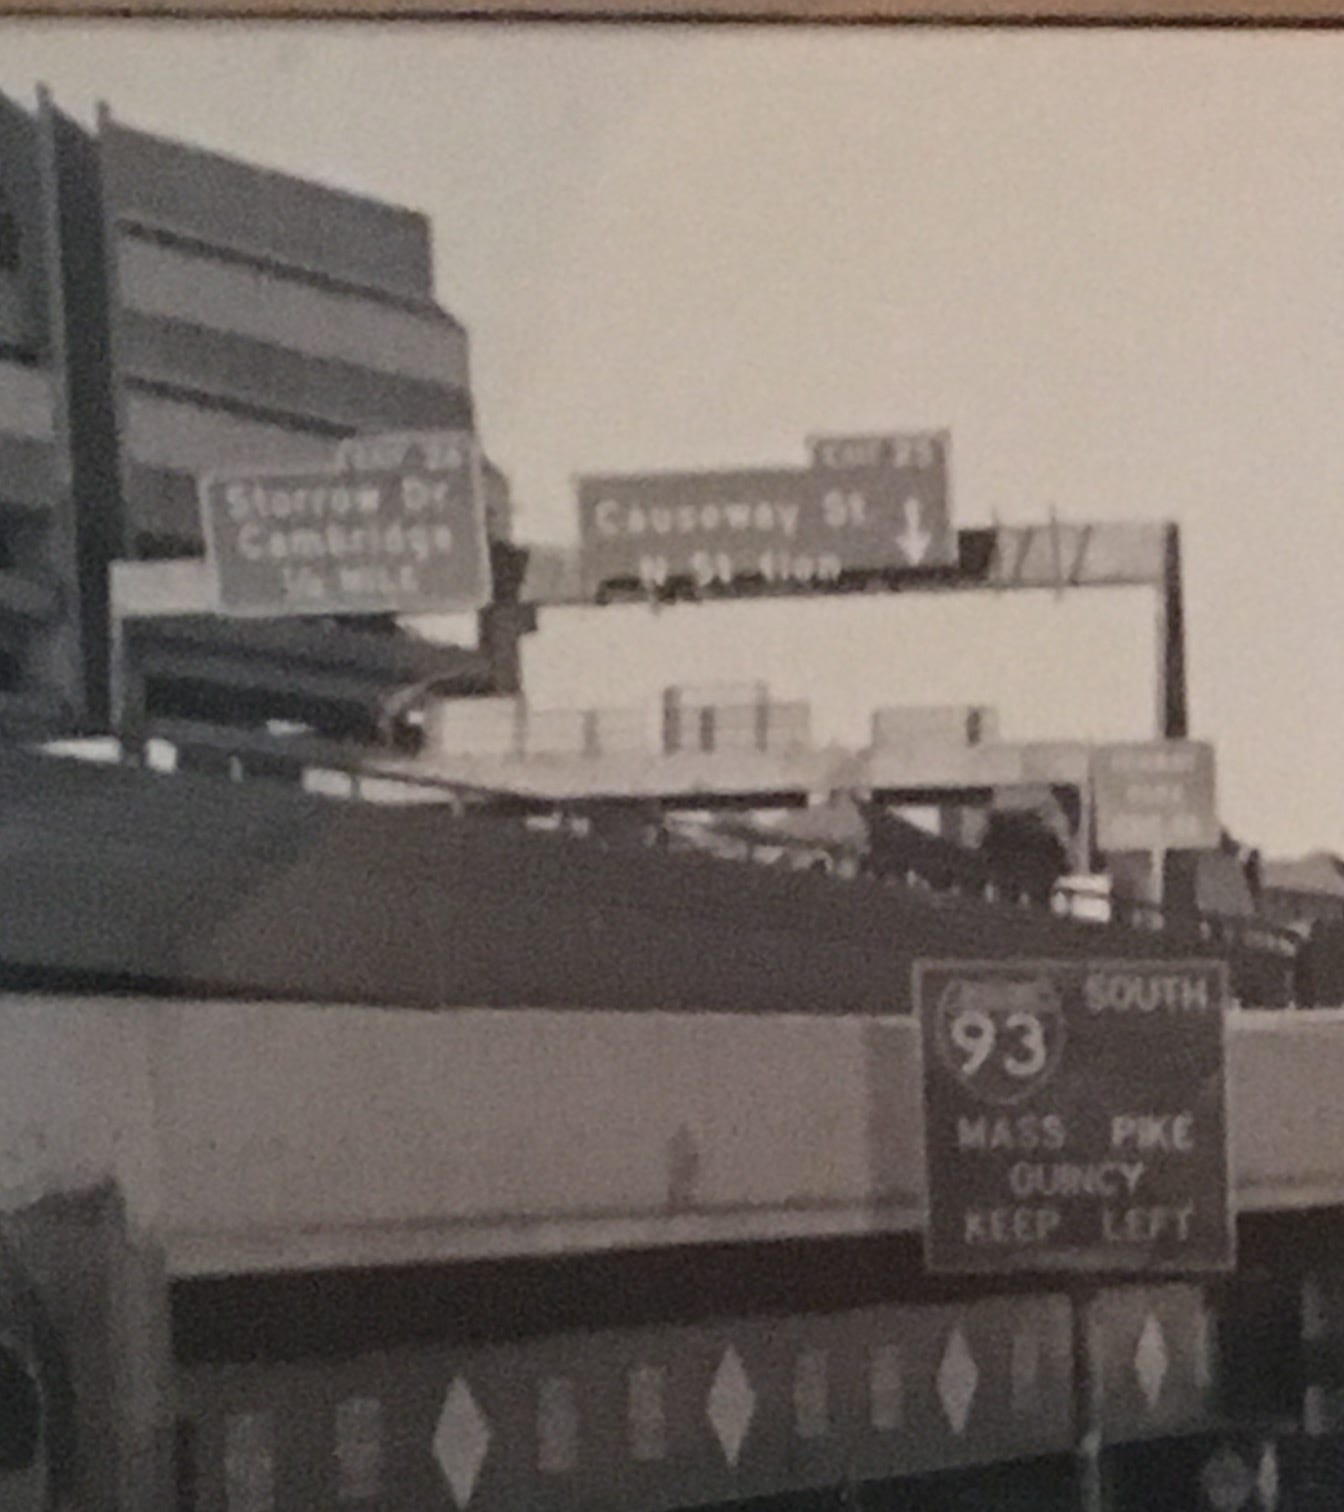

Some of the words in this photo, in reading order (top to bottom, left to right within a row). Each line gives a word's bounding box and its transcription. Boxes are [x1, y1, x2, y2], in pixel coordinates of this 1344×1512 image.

[225, 486, 381, 519] Storrow
[401, 476, 448, 510] Dr
[595, 499, 799, 538] Causeway
[822, 490, 866, 528] St
[238, 521, 453, 561] Cambridge
[1084, 972, 1209, 1015] SOUTH
[951, 1009, 1047, 1077] 93
[957, 1112, 1066, 1152] MASS
[1009, 1160, 1144, 1196] QUINCY
[963, 1207, 1063, 1245] KEEP
[1101, 1201, 1194, 1242] LEFT
